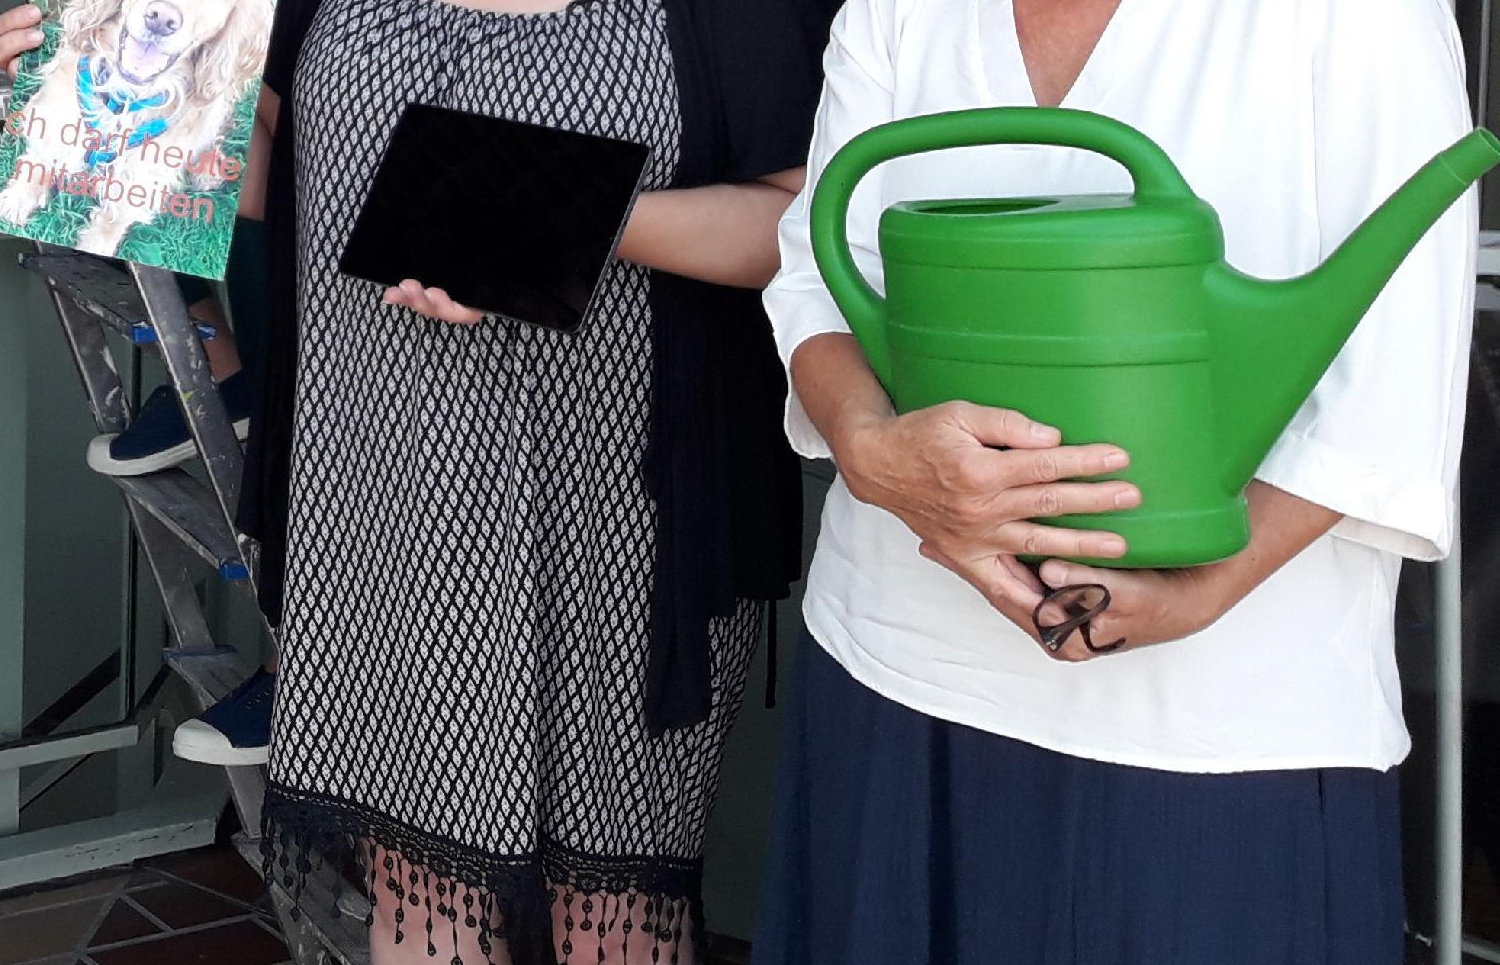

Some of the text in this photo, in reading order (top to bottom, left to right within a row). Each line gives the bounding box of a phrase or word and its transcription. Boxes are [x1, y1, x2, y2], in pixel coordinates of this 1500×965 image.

[4, 108, 243, 182] ch darf heute
[14, 158, 214, 224] mitarbeiten
